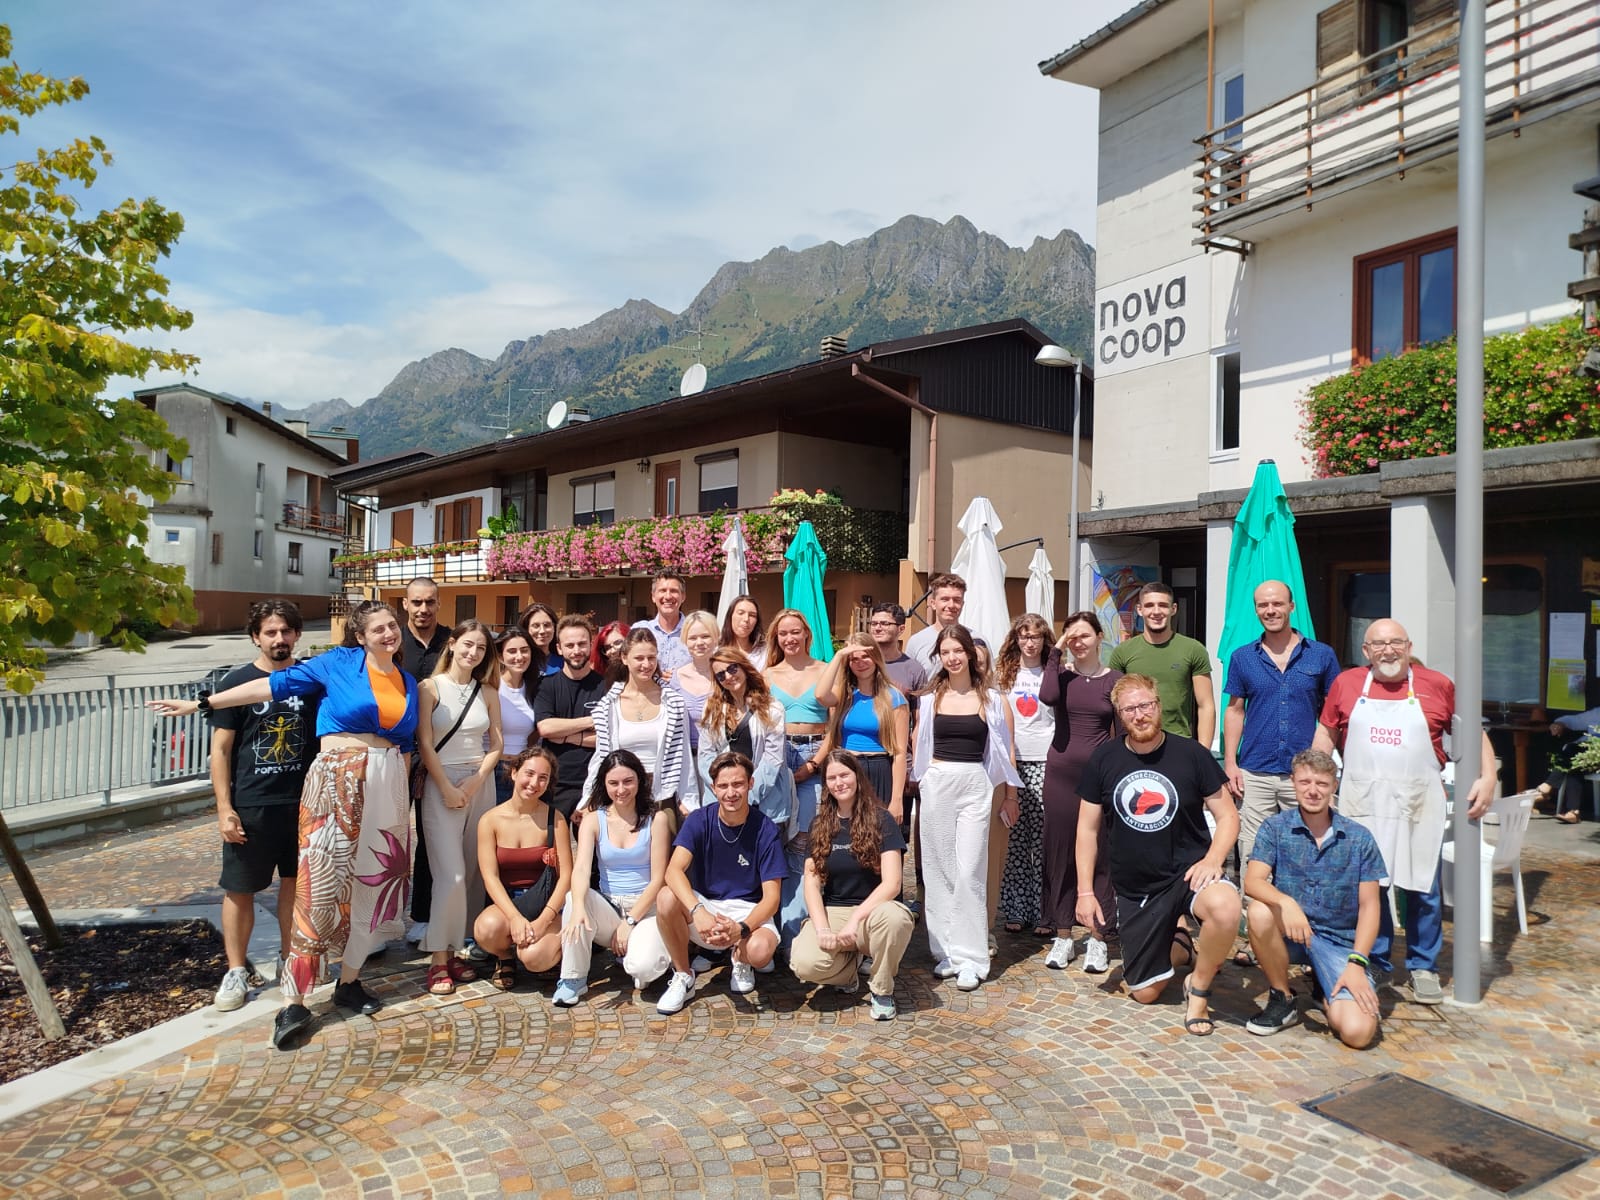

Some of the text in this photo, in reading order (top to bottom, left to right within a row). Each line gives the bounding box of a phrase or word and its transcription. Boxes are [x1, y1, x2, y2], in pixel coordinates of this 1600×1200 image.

[1100, 275, 1186, 331] nova
[1100, 316, 1186, 364] coop
[1370, 726, 1402, 736] nova
[1370, 735, 1402, 747] coop
[1125, 815, 1171, 830] ANTIFASCISTA
